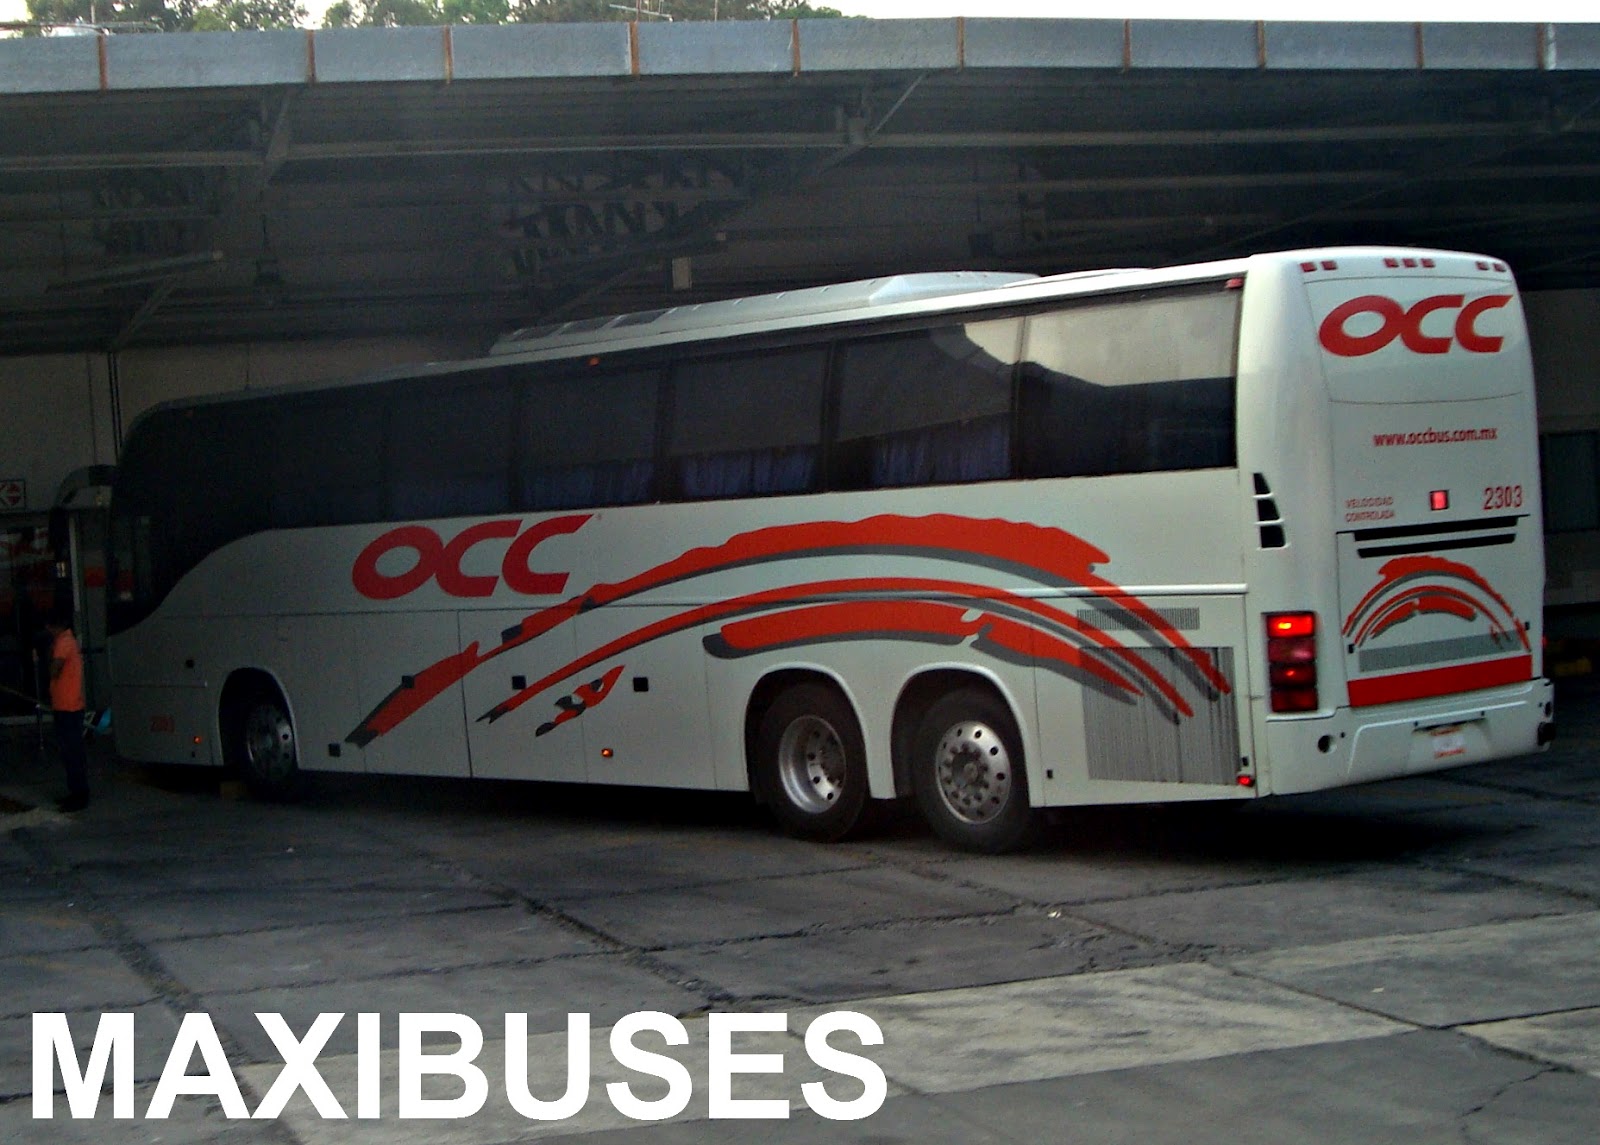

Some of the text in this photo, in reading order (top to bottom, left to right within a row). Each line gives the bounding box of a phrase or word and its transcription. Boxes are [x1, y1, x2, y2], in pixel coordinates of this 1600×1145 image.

[1318, 294, 1514, 357] OCC
[1372, 427, 1498, 447] www.occbus.com.mx
[1483, 485, 1523, 510] 2303
[352, 513, 593, 600] OCC
